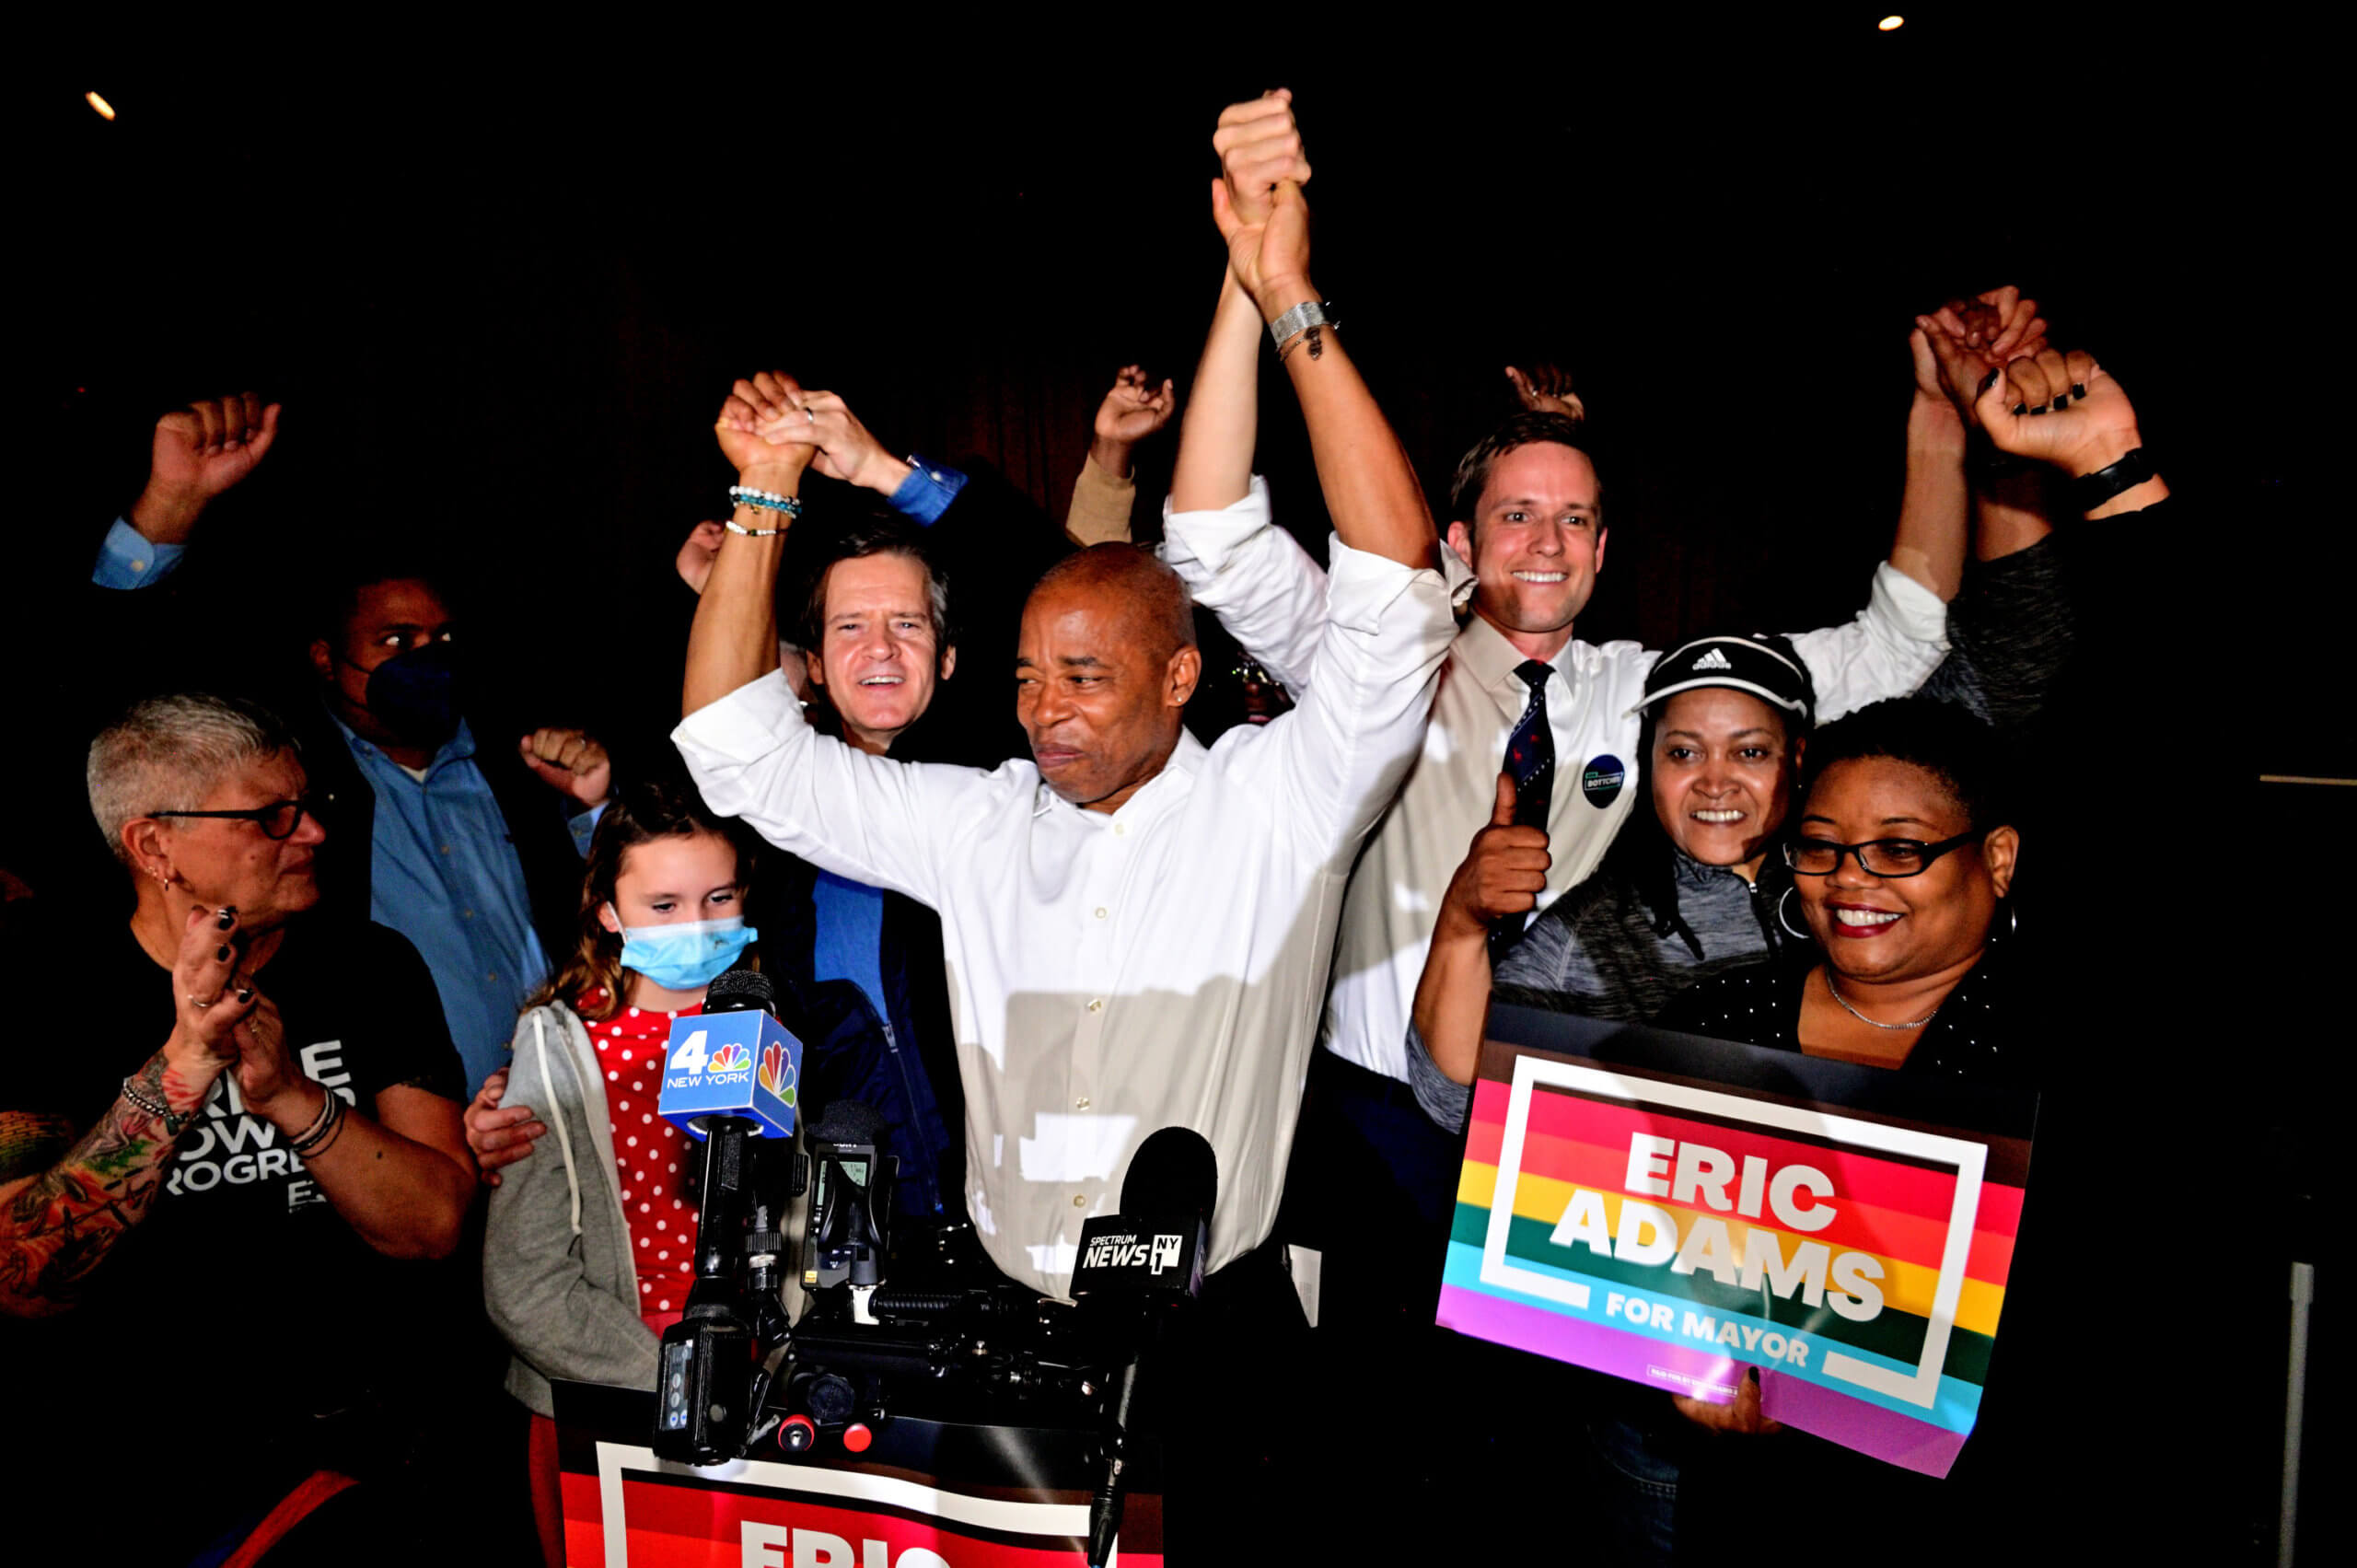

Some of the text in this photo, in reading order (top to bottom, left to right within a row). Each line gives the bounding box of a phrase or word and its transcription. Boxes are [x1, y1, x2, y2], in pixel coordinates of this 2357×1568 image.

[670, 1030, 709, 1074] 4
[668, 1072, 749, 1089] NEW YORK
[1625, 1132, 1837, 1232] ERIC
[1090, 1235, 1137, 1247] SPECTRUM
[1157, 1237, 1178, 1249] NY
[1083, 1245, 1150, 1269] NEWS
[1154, 1253, 1162, 1272] 1
[1550, 1189, 1885, 1322] ADAMS
[1607, 1292, 1809, 1367] FOR MAYOR
